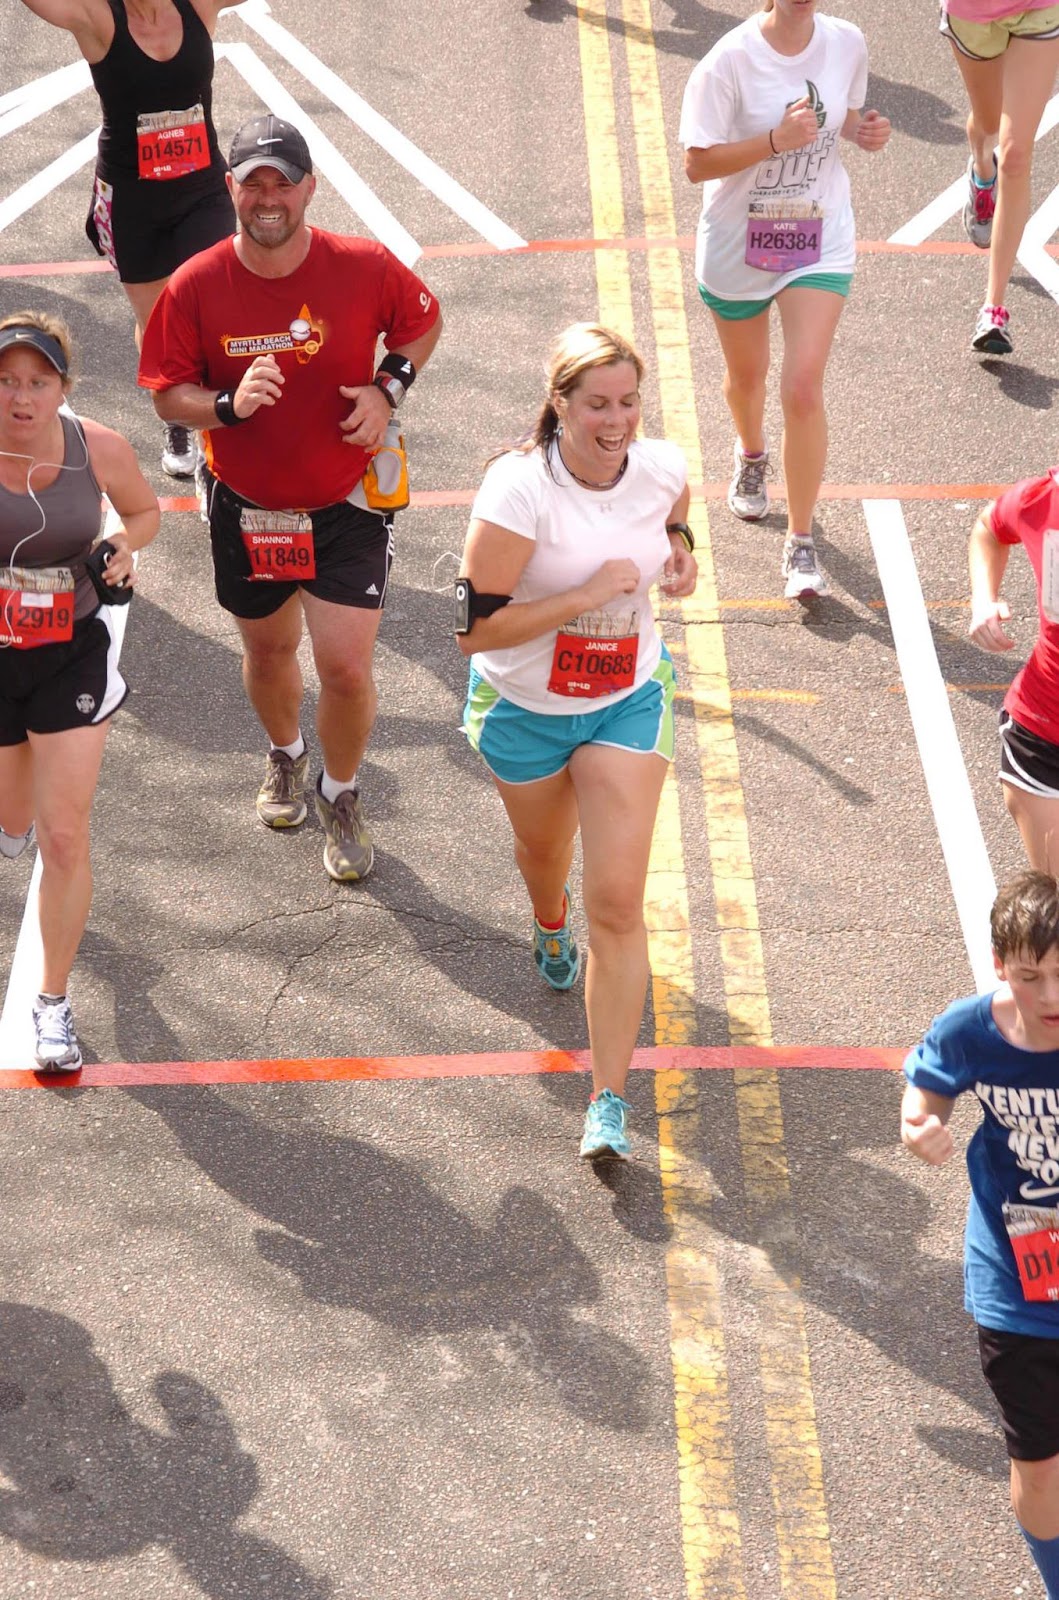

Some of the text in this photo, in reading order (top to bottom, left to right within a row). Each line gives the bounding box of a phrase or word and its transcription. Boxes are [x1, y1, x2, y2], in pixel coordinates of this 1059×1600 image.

[158, 129, 184, 140] AGNES
[142, 137, 203, 161] D14571
[773, 223, 798, 231] KATIE
[750, 232, 818, 250] H26384
[229, 341, 294, 354] MINI MARATHON
[230, 335, 292, 348] MYRTLE BEACH
[252, 536, 293, 544] SHANNON
[251, 547, 310, 567] 11849
[0, 605, 69, 628] 12919
[585, 642, 618, 651] JANICE
[557, 650, 634, 675] C10683
[1023, 1249, 1059, 1281] D1
